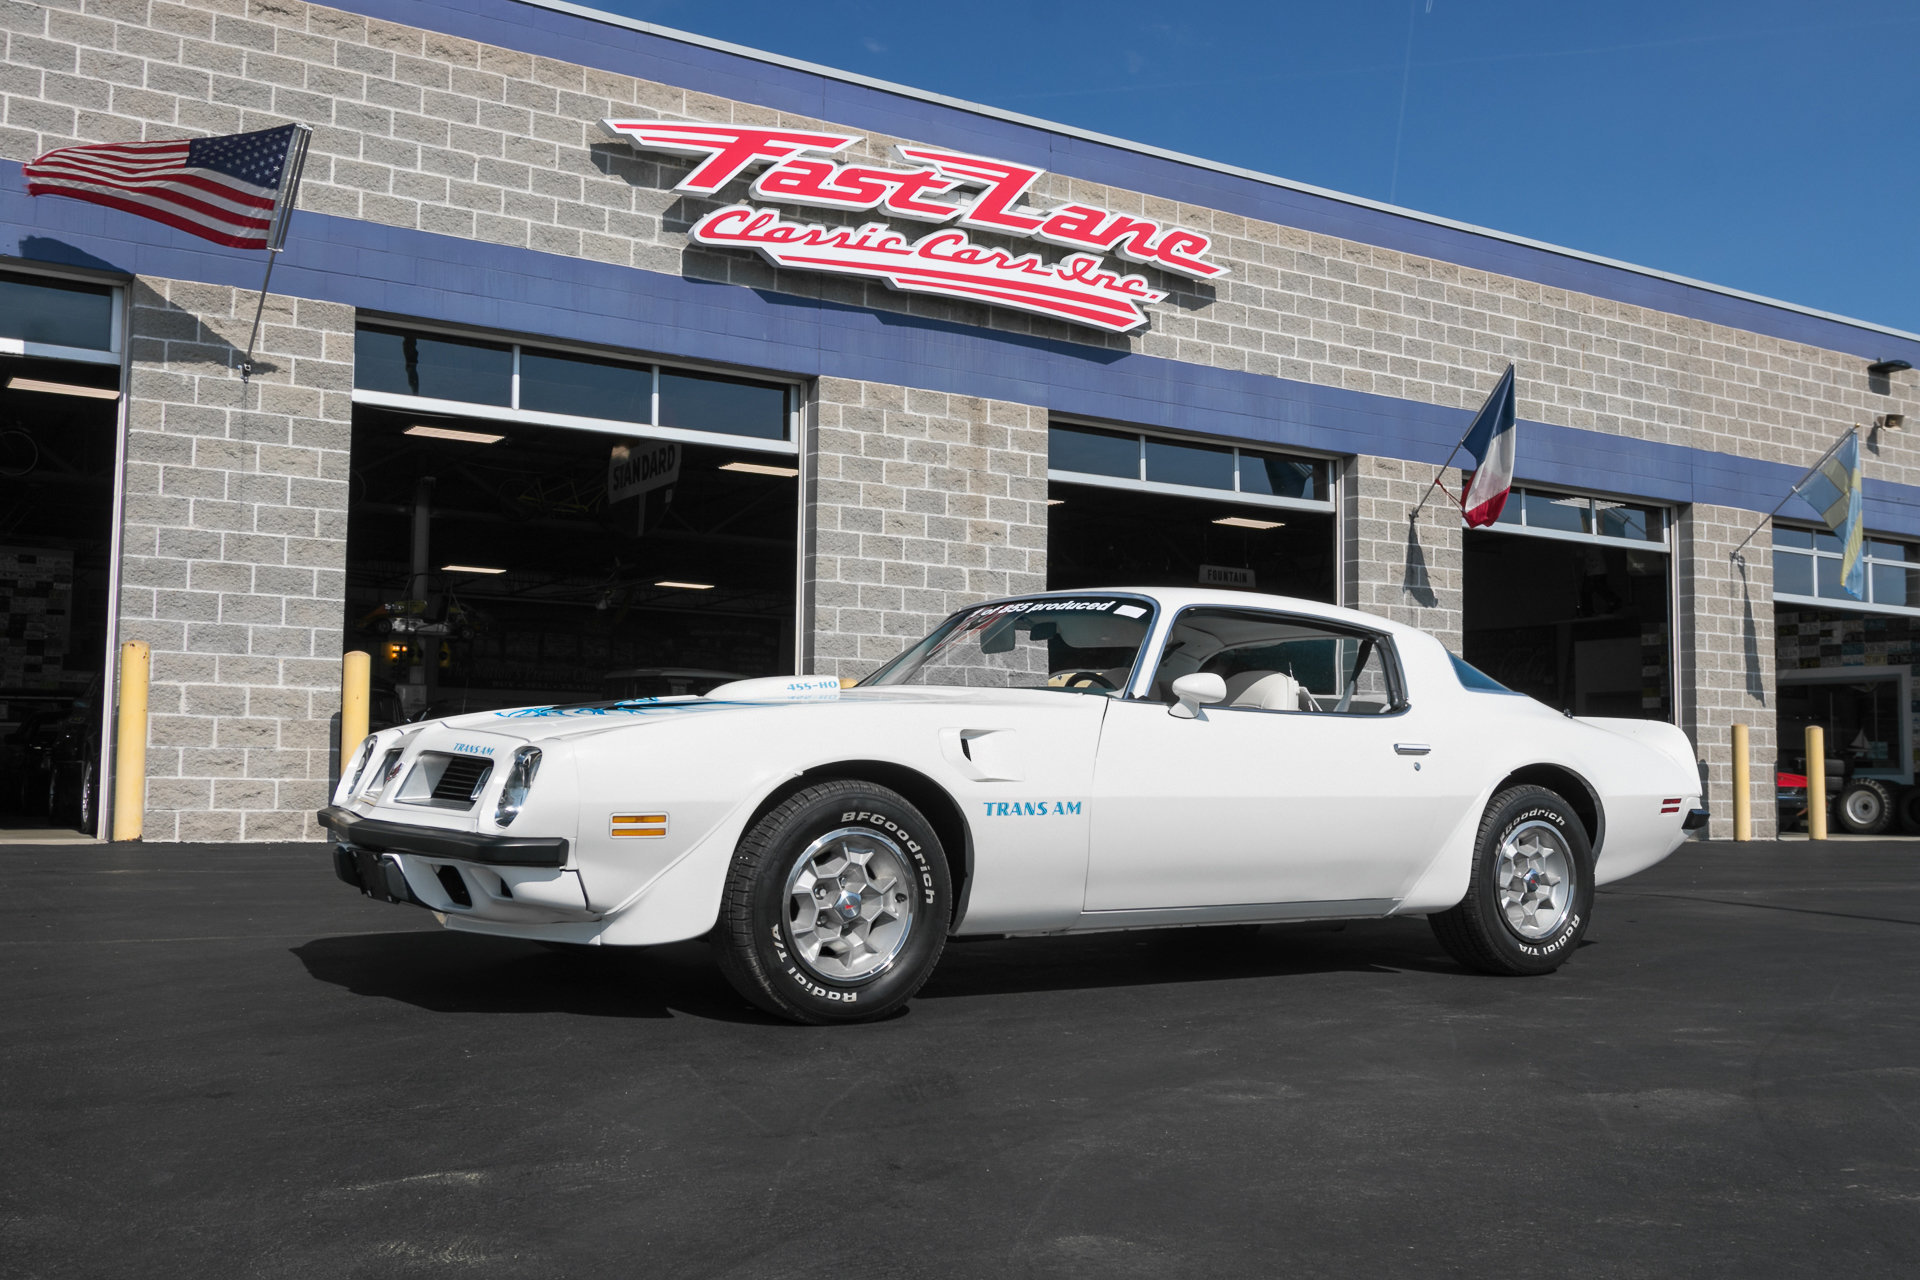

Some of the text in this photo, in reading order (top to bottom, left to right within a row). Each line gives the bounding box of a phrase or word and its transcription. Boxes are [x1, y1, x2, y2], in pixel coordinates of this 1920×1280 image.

[608, 121, 1221, 275] Fast Lane
[699, 209, 1159, 300] Classic Cars Inc.
[613, 445, 675, 491] STANDARD
[1207, 569, 1248, 584] FOUNTAIN
[1025, 600, 1116, 614] produced
[786, 681, 838, 691] 455-HO
[453, 742, 495, 756] TRANS AM
[983, 801, 1082, 816] TRANS AM
[840, 811, 935, 904] BFGoodrich
[1543, 913, 1581, 955] Radial
[771, 923, 858, 1003] Radial T/A
